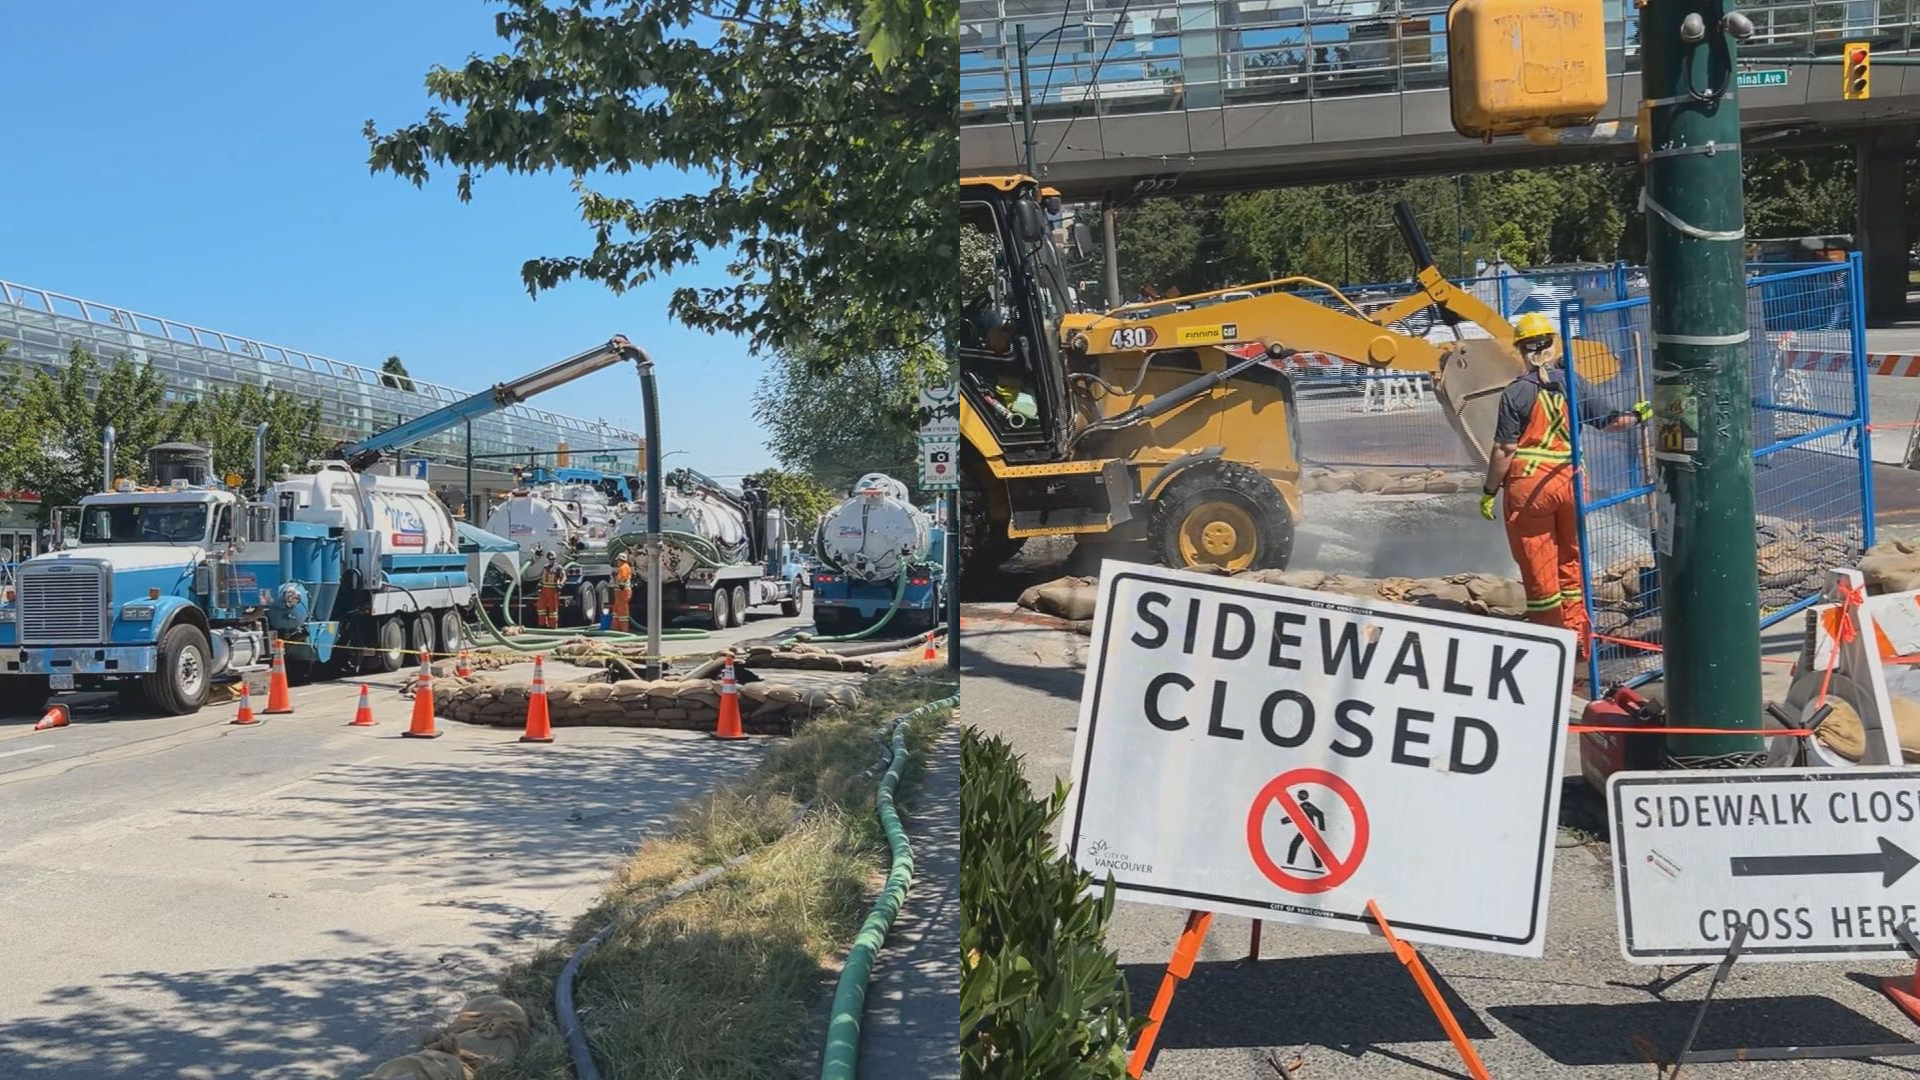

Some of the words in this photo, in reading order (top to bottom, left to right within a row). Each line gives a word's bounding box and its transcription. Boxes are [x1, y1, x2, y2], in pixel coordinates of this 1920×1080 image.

[1764, 74, 1782, 83] Ave
[1111, 327, 1147, 349] 430
[1223, 328, 1236, 338] CAT
[1131, 591, 1530, 705] SIDEWALK
[1144, 672, 1499, 775] CLOSED
[1634, 792, 1812, 828] SIDEWALK
[1828, 790, 1920, 824] CLOS
[1104, 852, 1119, 860] CITY
[1094, 858, 1153, 873] VANCOUVER
[1297, 907, 1335, 917] VANCOUVER
[1699, 907, 1813, 942] CROSS
[1831, 905, 1920, 938] HERE
